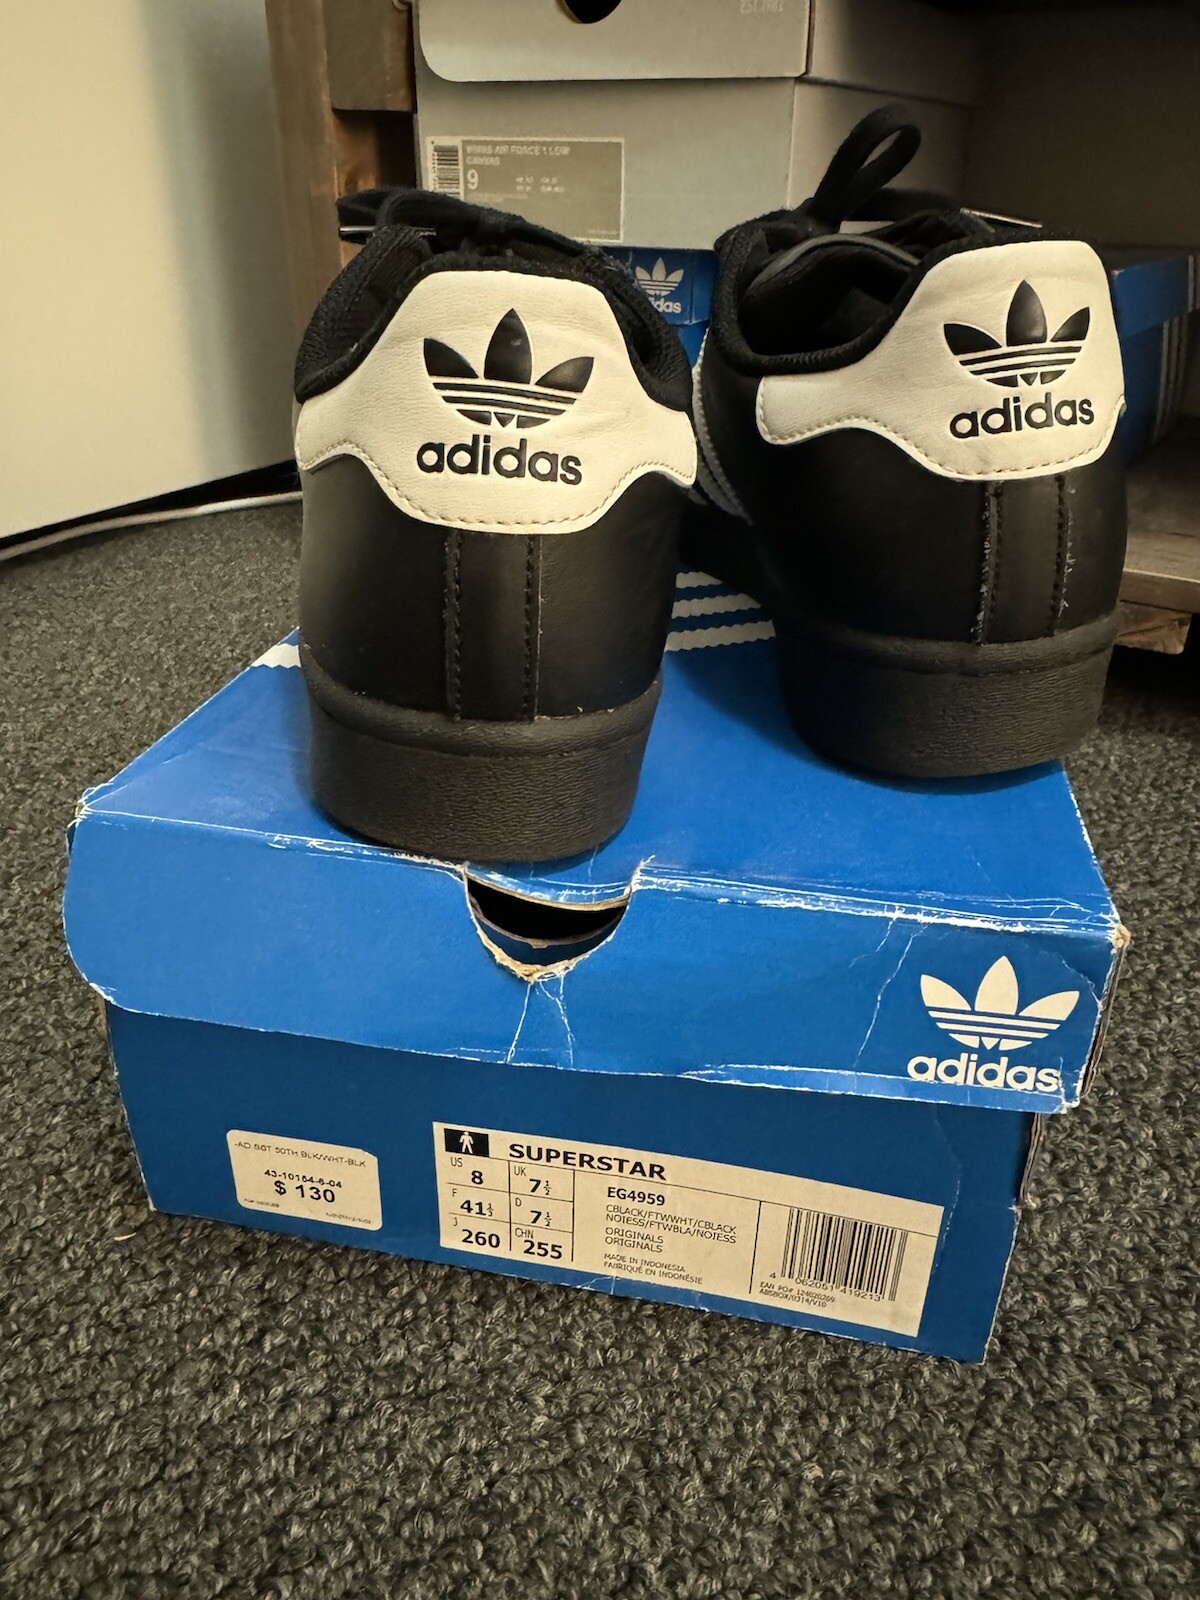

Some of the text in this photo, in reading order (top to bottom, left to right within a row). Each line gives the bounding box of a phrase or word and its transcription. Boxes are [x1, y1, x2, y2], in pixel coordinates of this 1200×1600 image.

[467, 169, 478, 190] 9
[949, 392, 1094, 439] adidas
[416, 434, 582, 485] adidas
[907, 1053, 1060, 1092] adidas
[450, 1157, 463, 1168] US
[509, 1143, 667, 1180] SUPERSTAR
[513, 1166, 527, 1177] UK
[471, 1170, 483, 1185] 8
[274, 1180, 287, 1196] $
[295, 1184, 335, 1203] 130
[452, 1189, 457, 1198] F
[607, 1186, 666, 1206] EG4959
[515, 1197, 522, 1207] D
[605, 1214, 737, 1244] NOIESS/FTWBLA/NOIESS
[606, 1205, 737, 1235] CBLACK/FTWWHT/CBLACK
[461, 1229, 500, 1249] 260
[515, 1228, 535, 1239] CHN
[605, 1227, 664, 1244] ORIGINALS
[523, 1239, 563, 1260] 255
[604, 1237, 663, 1253] ORIGINALS
[604, 1253, 686, 1273] MADE IN INDONESIA
[645, 1269, 656, 1277] EN
[795, 1277, 834, 1292] 062051
[840, 1288, 882, 1302] 419213
